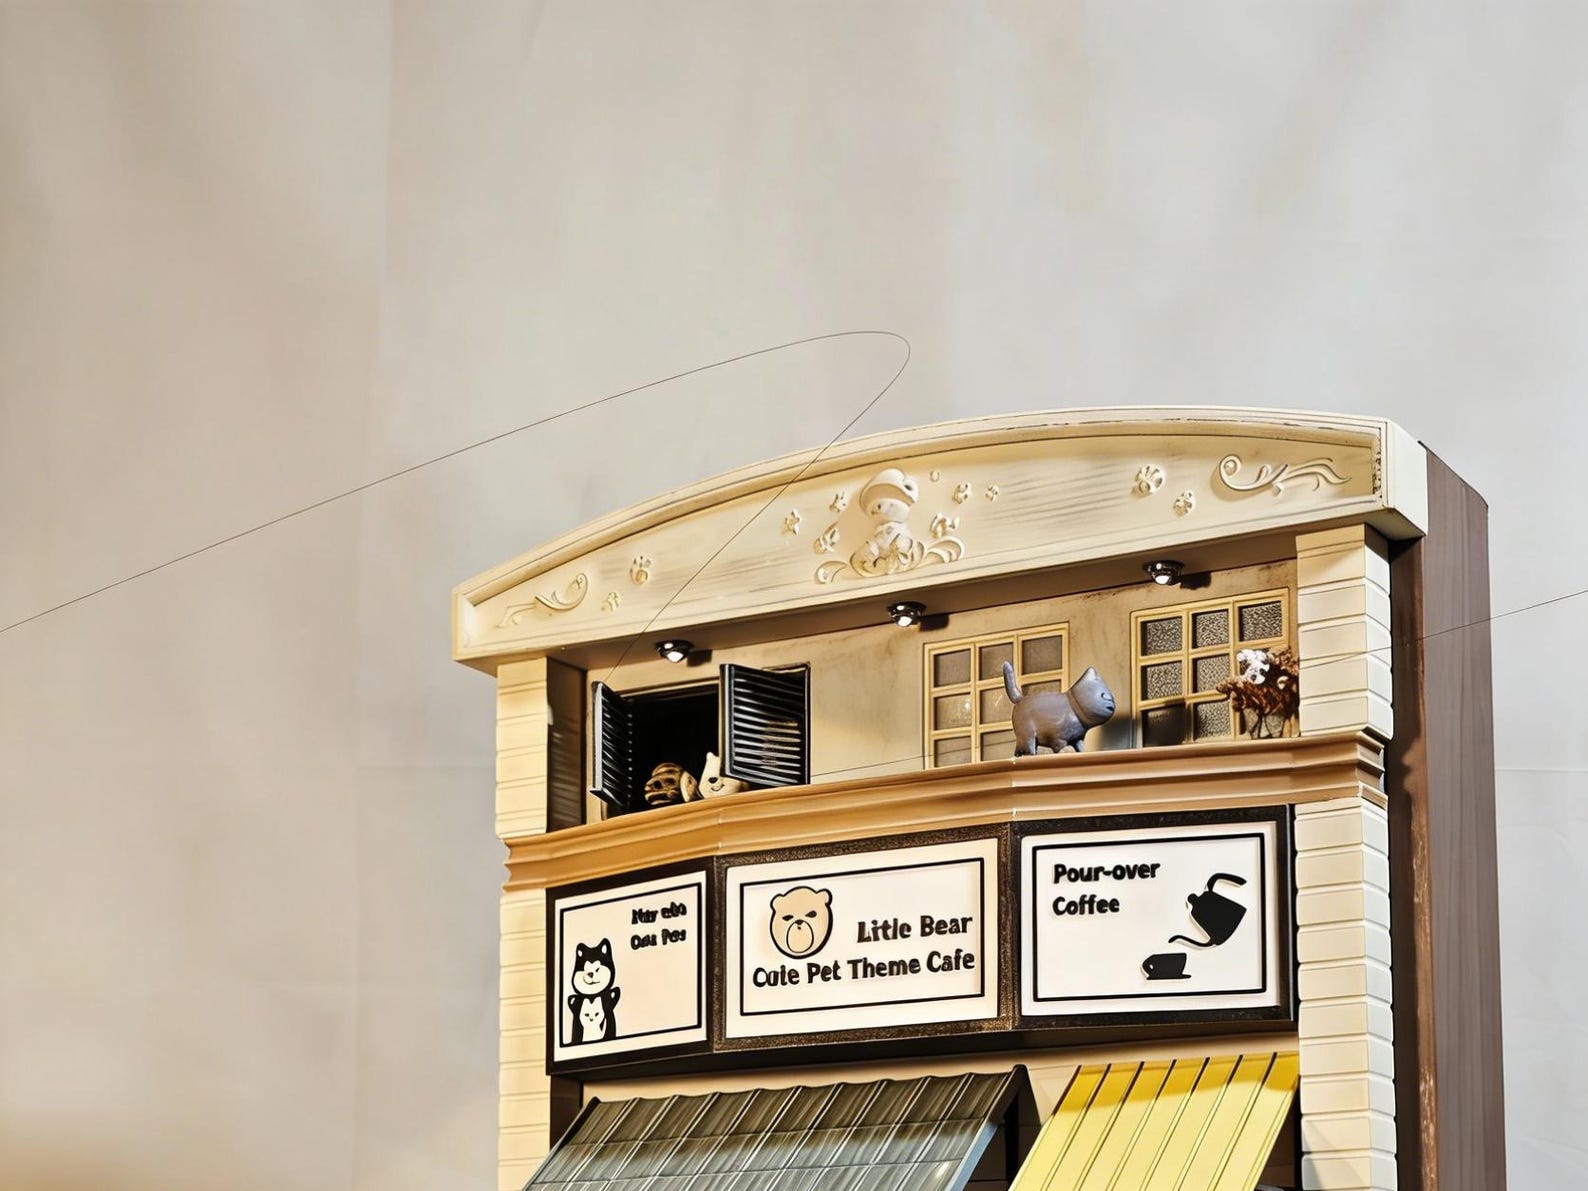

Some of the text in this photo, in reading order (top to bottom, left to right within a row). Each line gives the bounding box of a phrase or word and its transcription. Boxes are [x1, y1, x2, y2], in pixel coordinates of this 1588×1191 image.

[1053, 863, 1161, 884] Pour-over
[1052, 894, 1120, 916] Coffee
[920, 915, 973, 937] Bear
[806, 960, 842, 984] Pet
[847, 957, 922, 980] Theme
[926, 948, 975, 973] Cafe
